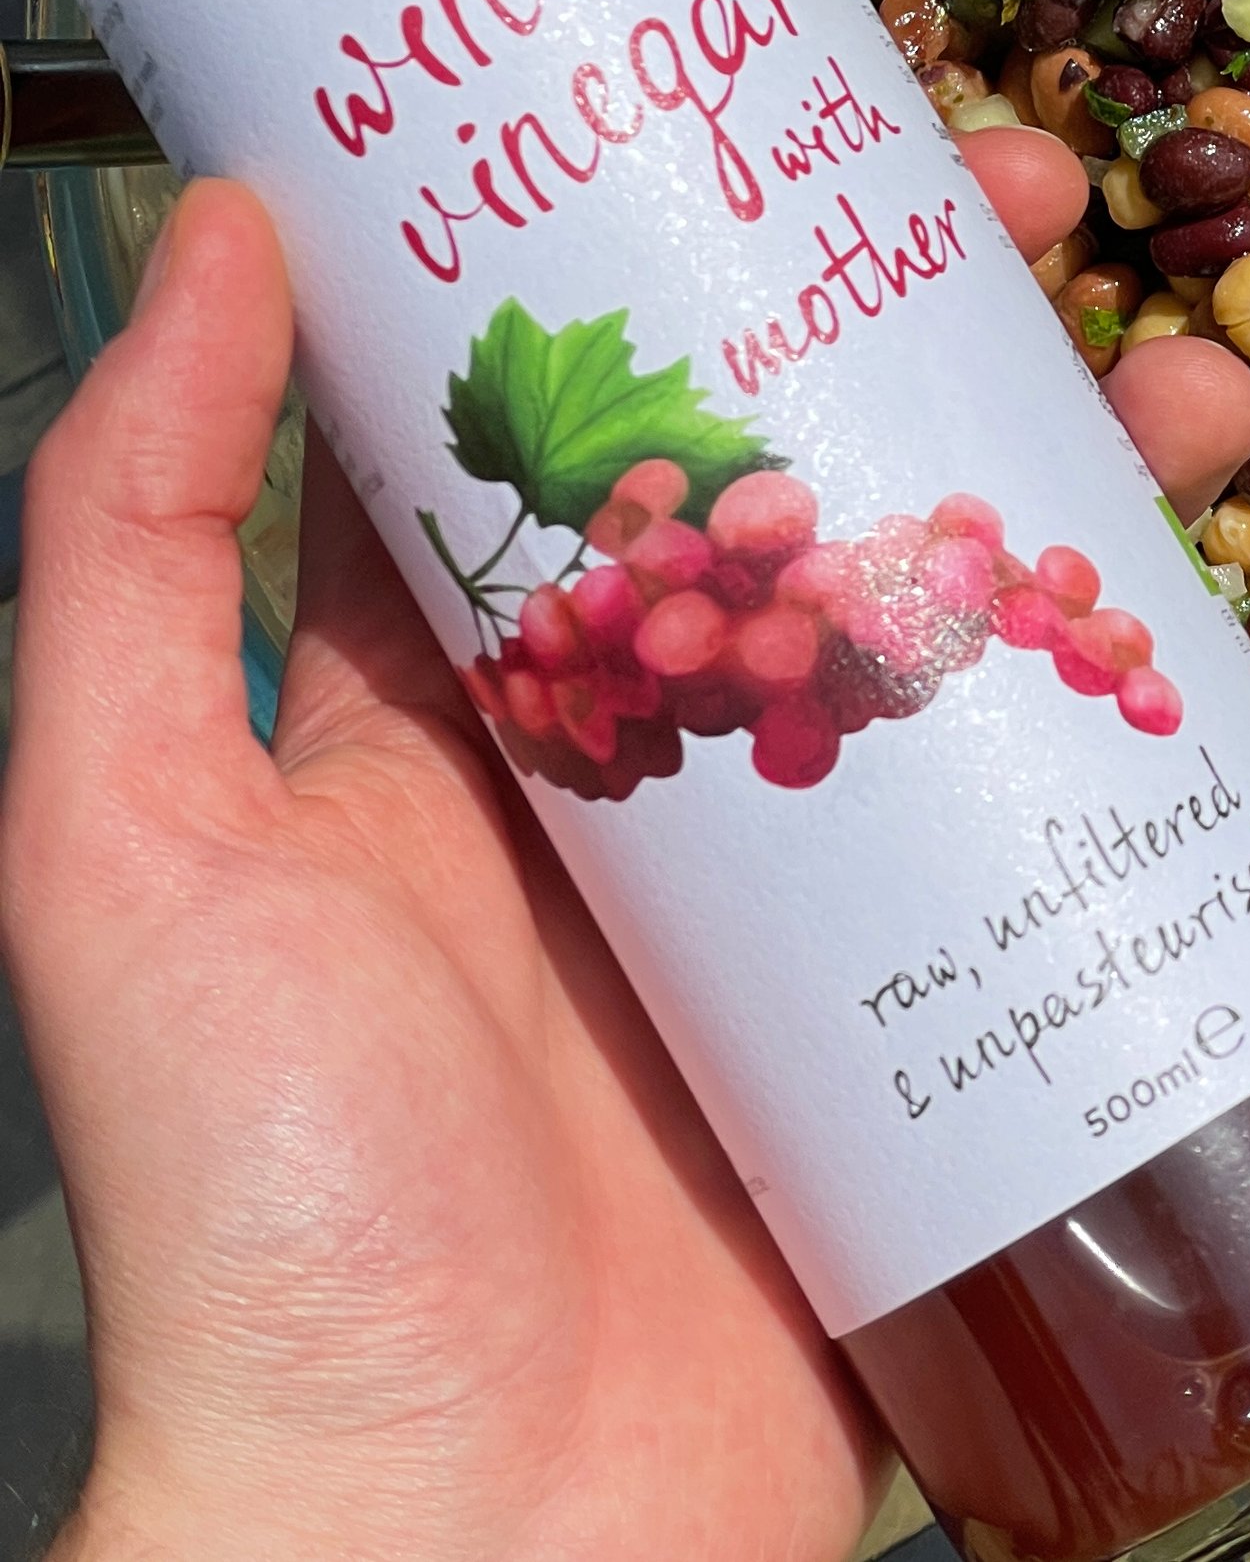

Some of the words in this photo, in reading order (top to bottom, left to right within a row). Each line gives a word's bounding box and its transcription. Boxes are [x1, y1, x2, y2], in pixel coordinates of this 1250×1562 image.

[771, 56, 901, 182] with
[722, 193, 967, 397] mother
[860, 948, 981, 1027] raw,
[984, 745, 1241, 951] unfiltered
[894, 1069, 931, 1120] &
